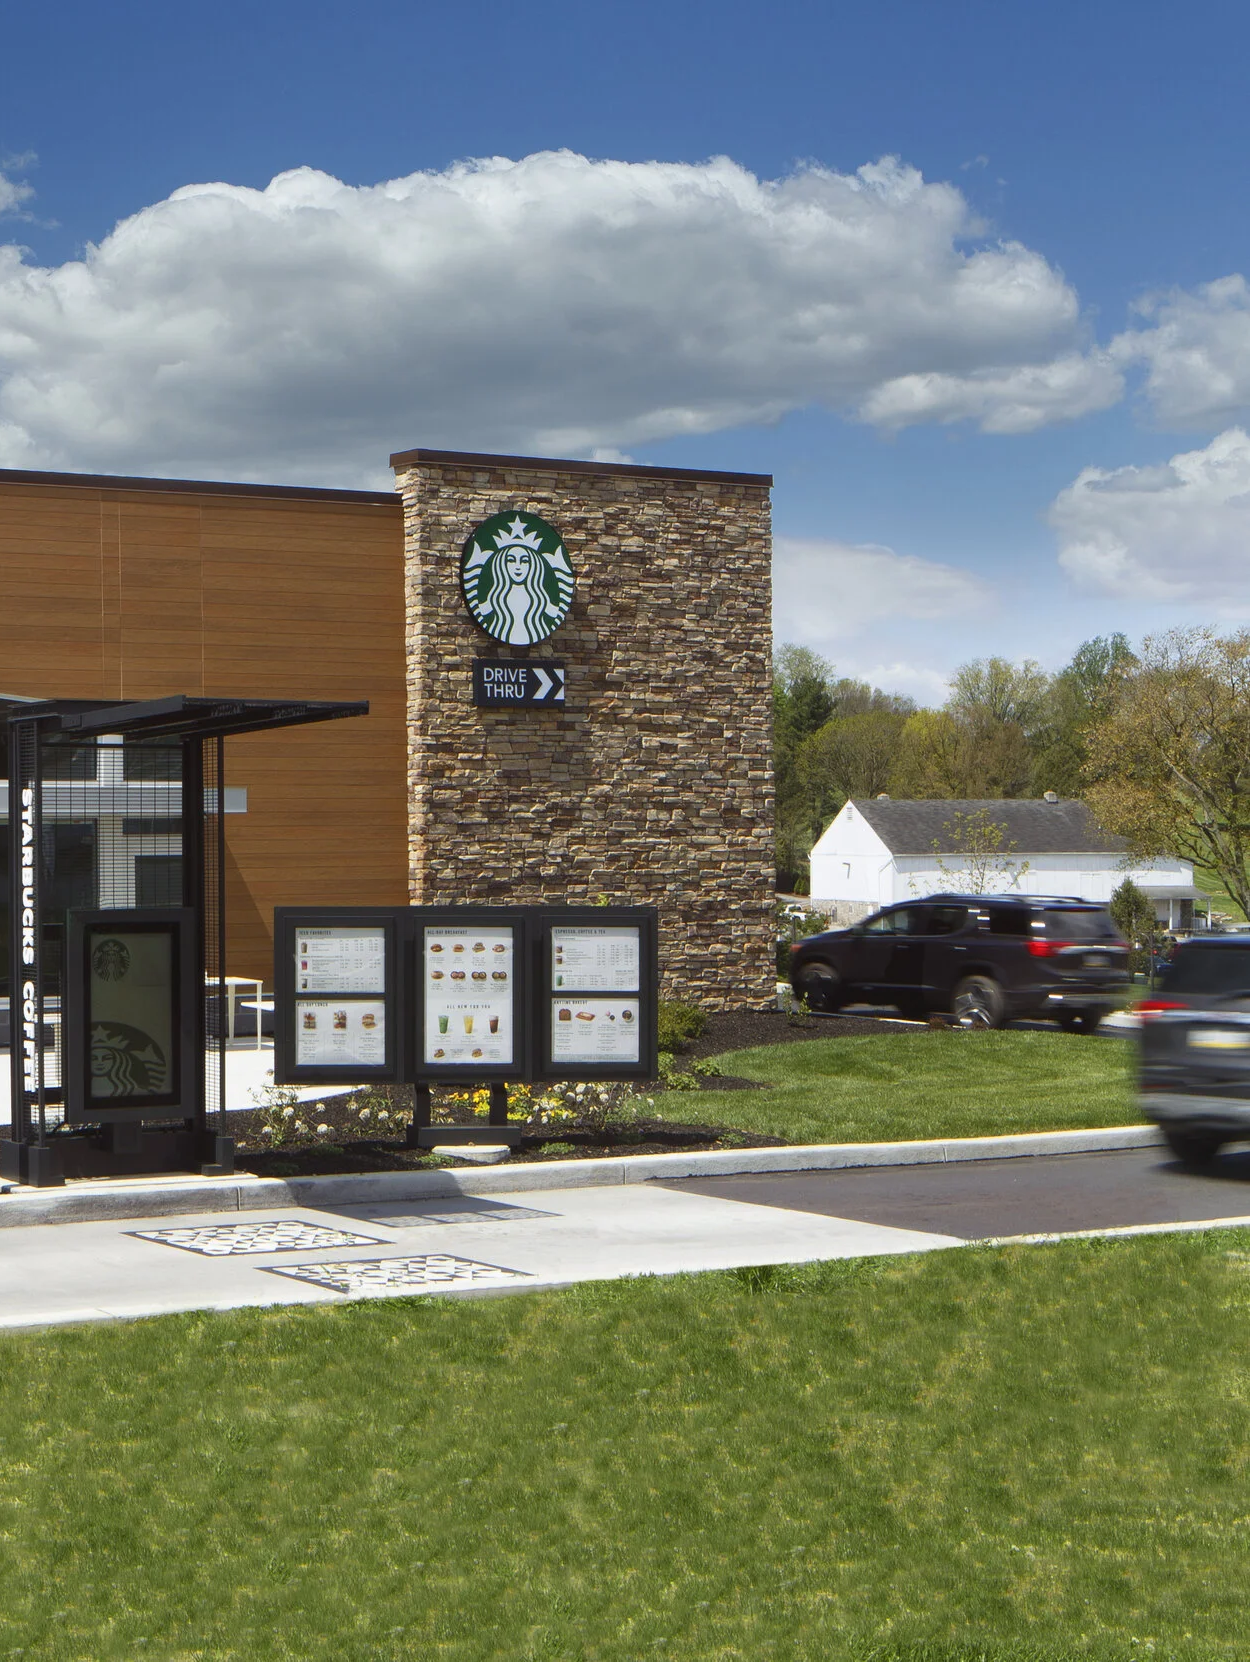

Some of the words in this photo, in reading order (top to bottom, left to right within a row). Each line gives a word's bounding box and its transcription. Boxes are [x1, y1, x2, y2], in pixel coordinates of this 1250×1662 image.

[483, 667, 527, 682] DRIVE
[483, 683, 525, 698] THRU
[21, 788, 35, 965] STARBUCKS
[22, 980, 36, 1093] COFFEE
